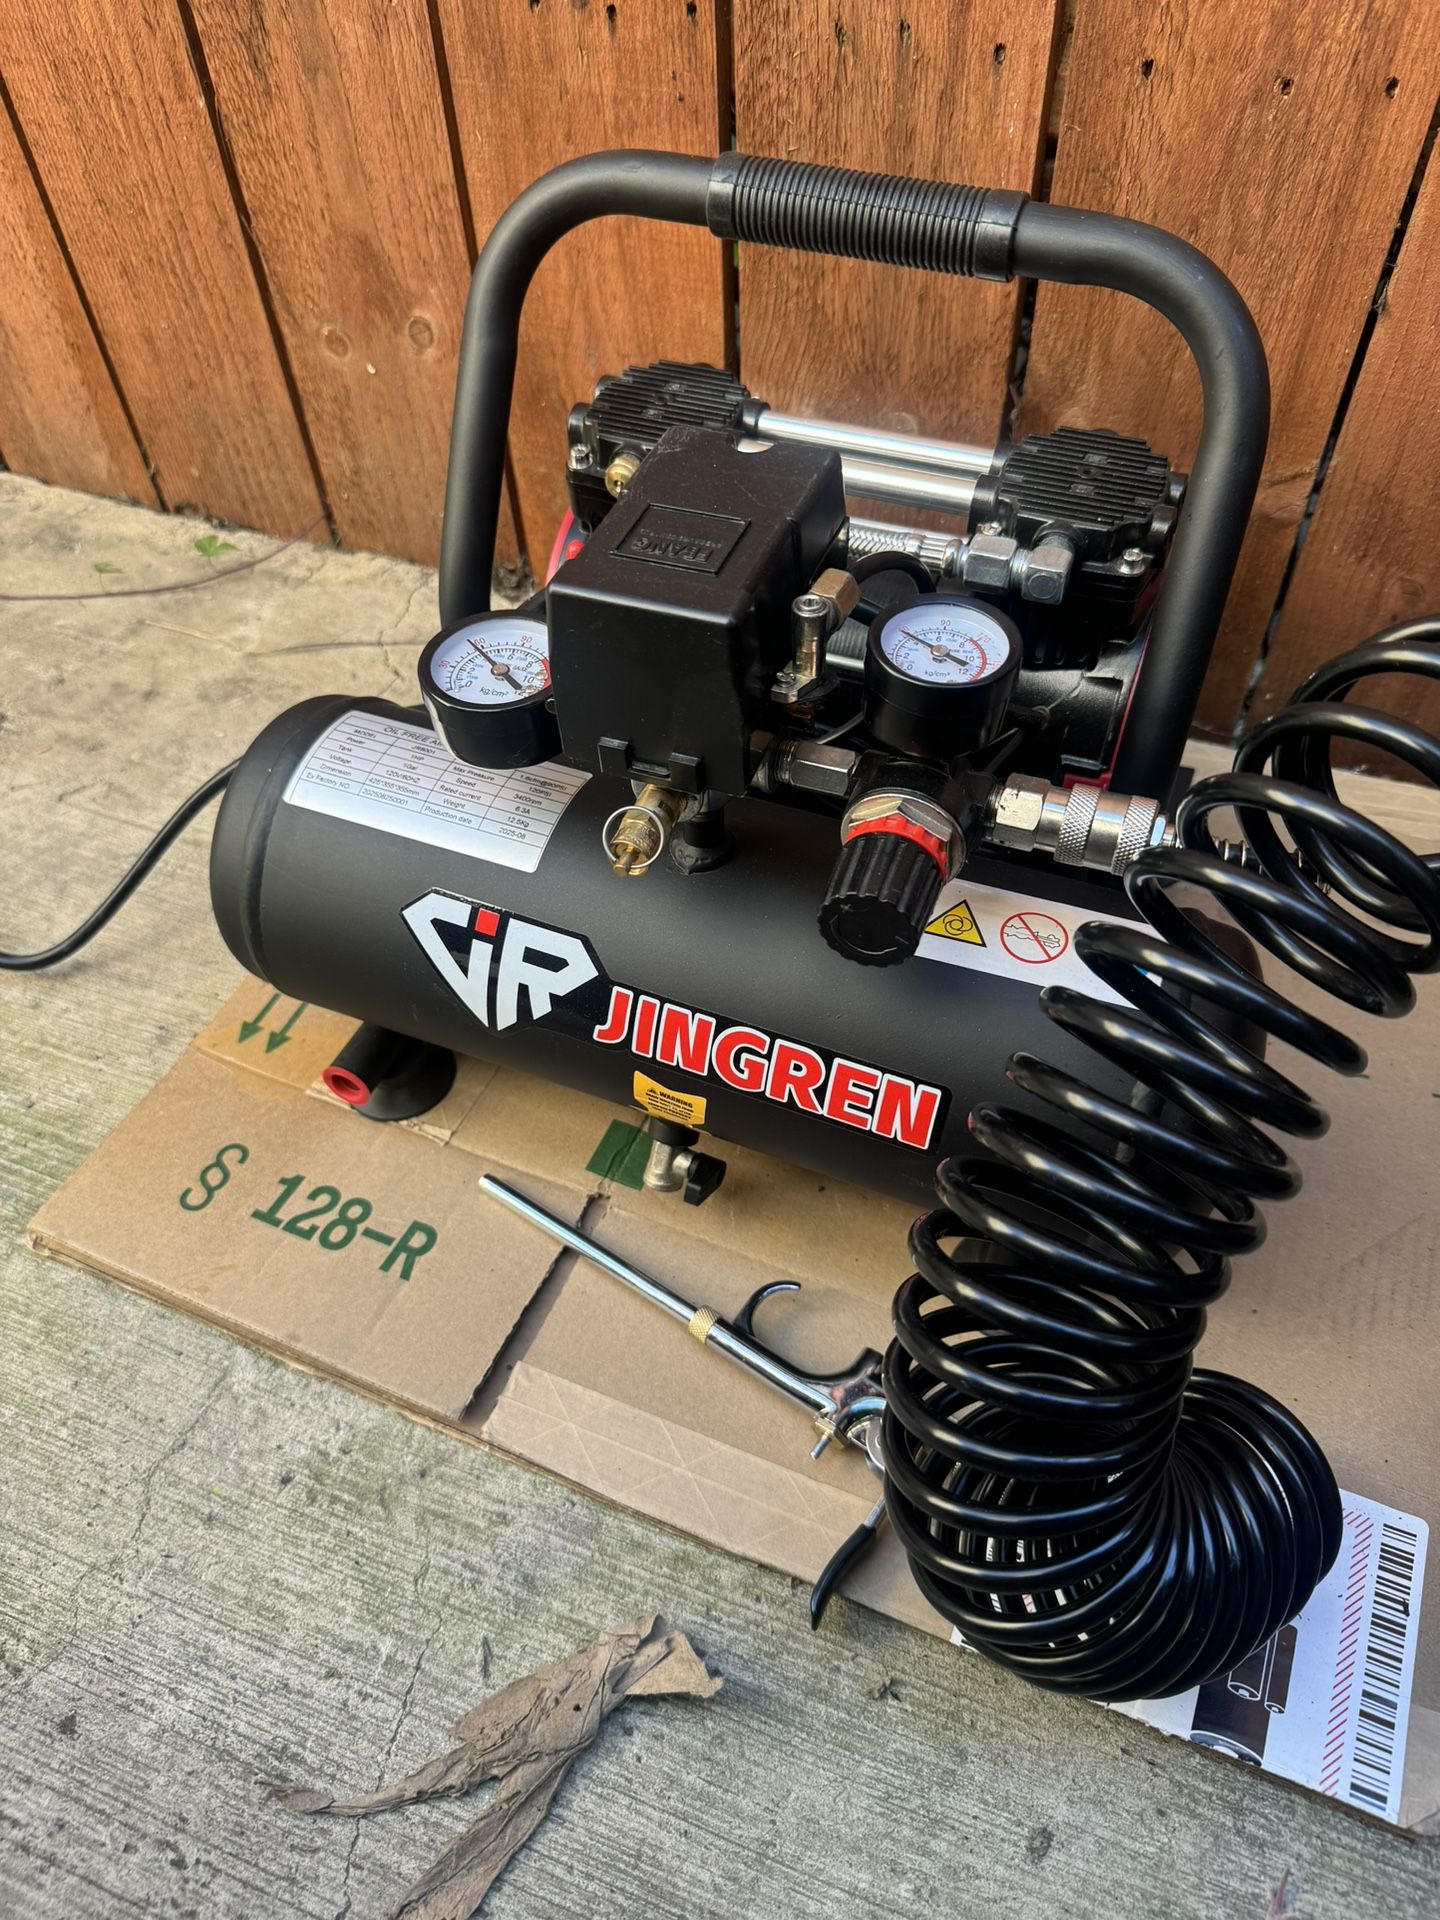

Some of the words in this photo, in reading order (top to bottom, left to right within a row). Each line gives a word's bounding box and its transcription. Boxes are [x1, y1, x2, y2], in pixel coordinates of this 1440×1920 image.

[520, 634, 533, 643] 90
[526, 660, 533, 668] 8
[384, 726, 398, 735] OIL
[401, 731, 428, 742] FREE
[338, 745, 353, 753] Tank
[330, 754, 352, 764] Voltage
[320, 763, 352, 777] Dimension
[453, 766, 466, 774] Max
[467, 770, 495, 781] Pressure
[315, 773, 337, 786] Factory
[456, 778, 477, 788] Speed
[440, 784, 458, 794] Rated
[458, 791, 482, 801] current
[443, 799, 466, 809] Weight
[424, 806, 457, 821] Production
[458, 816, 473, 825] date
[593, 985, 942, 1150] JINGREN
[659, 1090, 693, 1108] WARNING
[250, 1173, 438, 1282] 128-R
